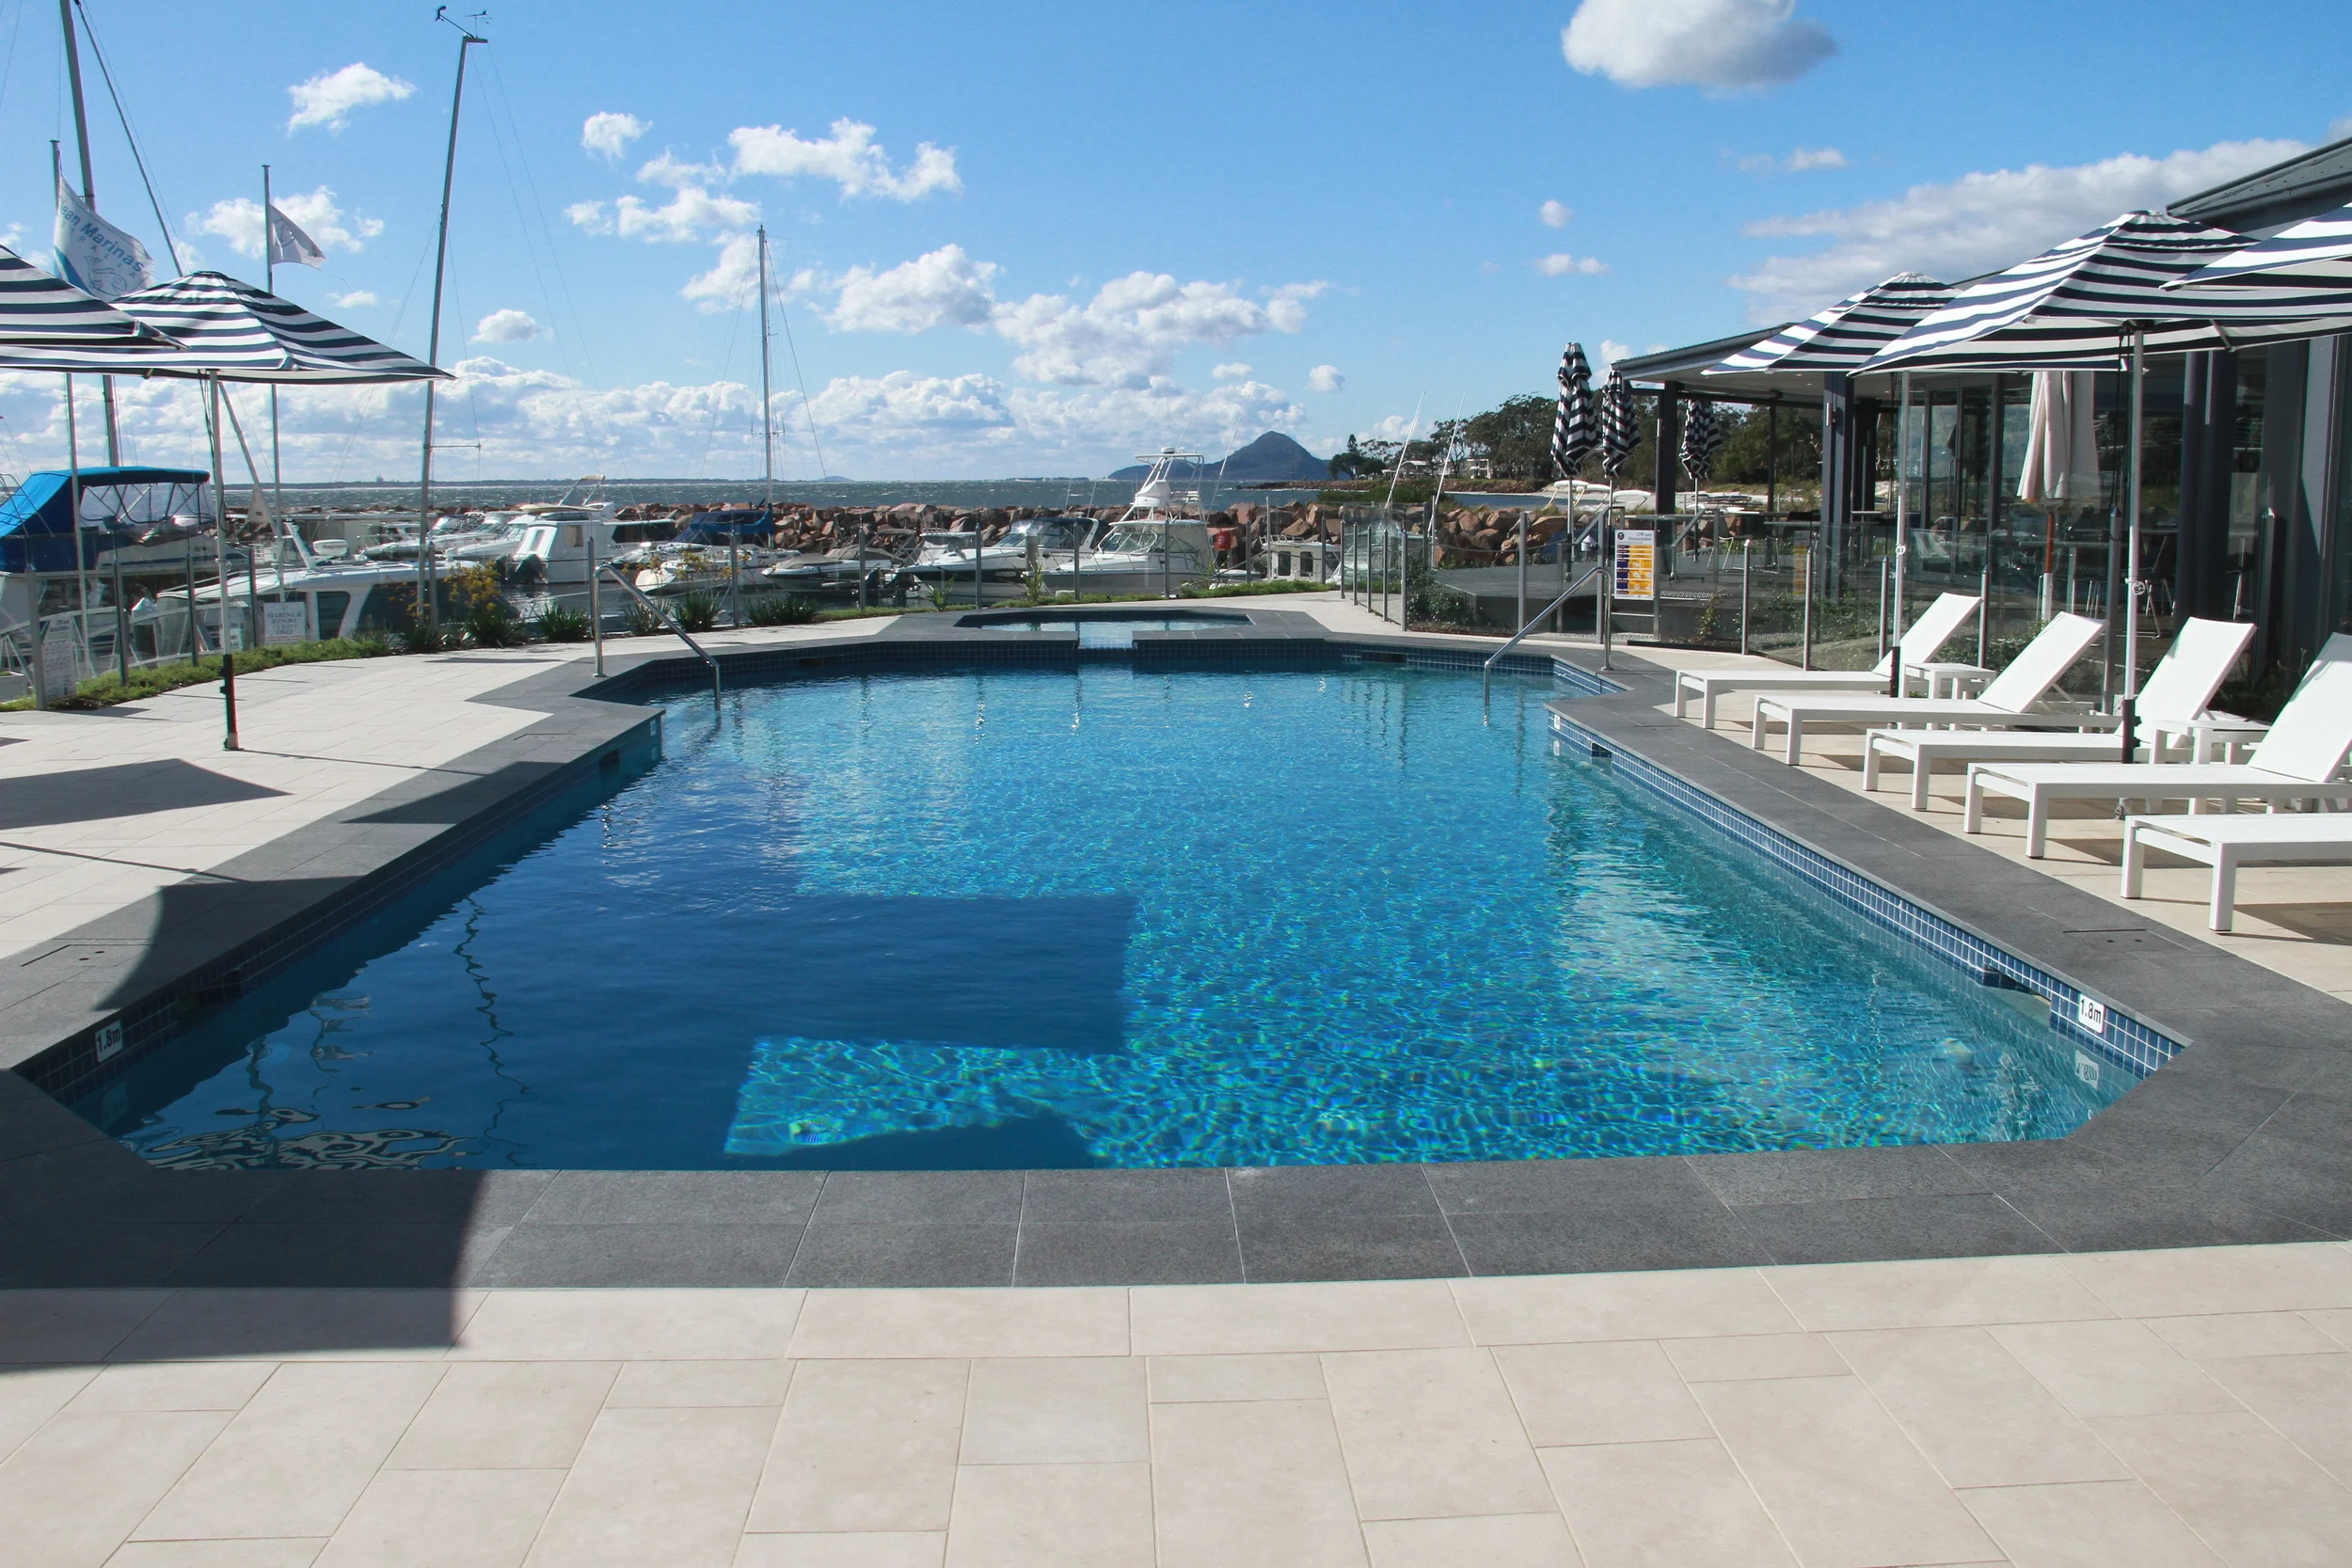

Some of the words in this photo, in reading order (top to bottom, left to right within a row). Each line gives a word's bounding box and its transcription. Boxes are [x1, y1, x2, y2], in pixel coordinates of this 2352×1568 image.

[82, 223, 144, 272] Marinas
[2080, 999, 2102, 1023] 1.8m
[97, 1027, 121, 1053] 1.8m
